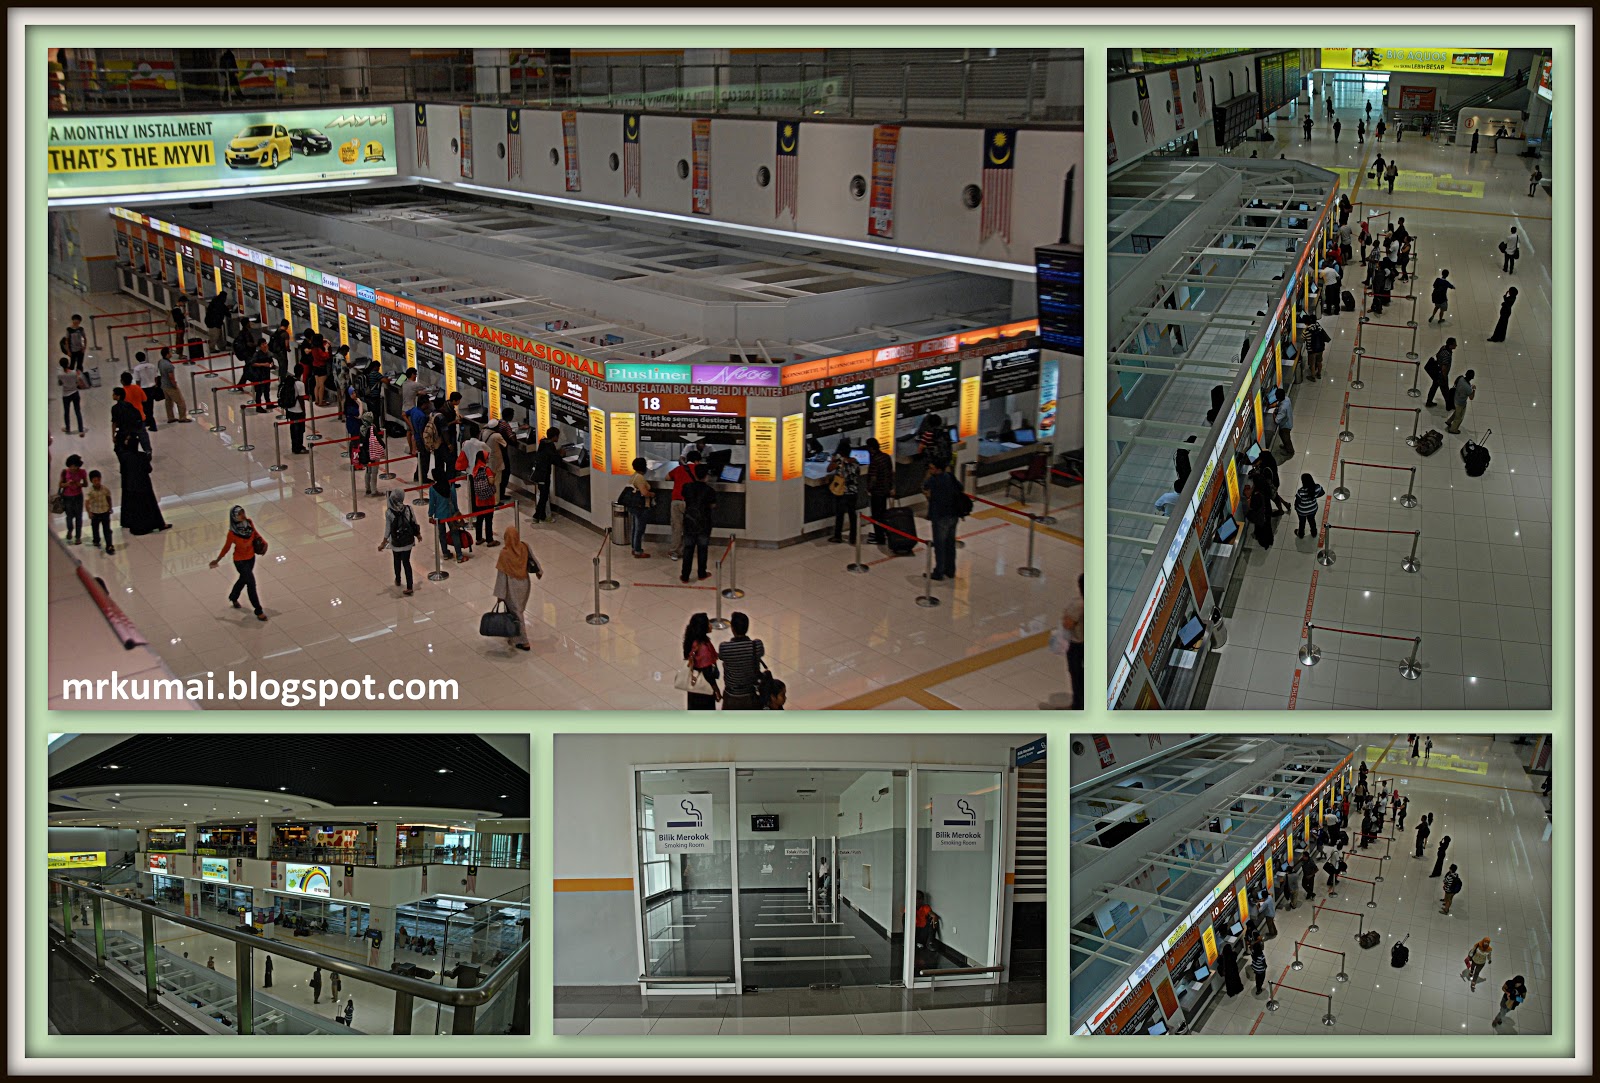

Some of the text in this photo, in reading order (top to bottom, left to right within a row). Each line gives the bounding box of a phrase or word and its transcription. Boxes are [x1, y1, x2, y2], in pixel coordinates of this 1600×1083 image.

[1387, 50, 1447, 62] BIG AQUOS
[51, 122, 213, 141] A MONTHLY INSTALMENT
[48, 144, 210, 170] THAT'S THE MYVI
[347, 304, 354, 315] 12
[416, 329, 423, 341] 14
[457, 343, 464, 356] 15
[463, 321, 605, 379] TRANSNASIONAL
[501, 359, 509, 372] 16
[984, 358, 993, 371] A
[608, 367, 689, 380] Plusliner
[551, 377, 561, 390] 17
[590, 379, 598, 389] KE
[598, 382, 634, 392] DESTINASI
[636, 384, 672, 394] SELATAN
[673, 384, 701, 395] BOLEH
[703, 385, 730, 395] DIBELI
[732, 386, 741, 396] DI
[742, 387, 782, 397] KAUNTER
[788, 382, 815, 394] HINGGA
[901, 375, 910, 389] B
[642, 397, 660, 411] 18
[809, 392, 820, 408] C
[1232, 427, 1240, 444] 10
[1170, 517, 1190, 562] 88
[1152, 571, 1178, 625] KAUNTER
[1146, 642, 1155, 656] 8
[676, 833, 709, 841] Merokok
[935, 831, 981, 839] Bilik Merokok
[1211, 906, 1219, 918] 10
[1135, 953, 1159, 979] 88
[1108, 1009, 1119, 1021] DI
[1118, 986, 1142, 1010] KAUNTER
[1143, 962, 1163, 983] HINGGA
[1110, 1022, 1118, 1033] 8
